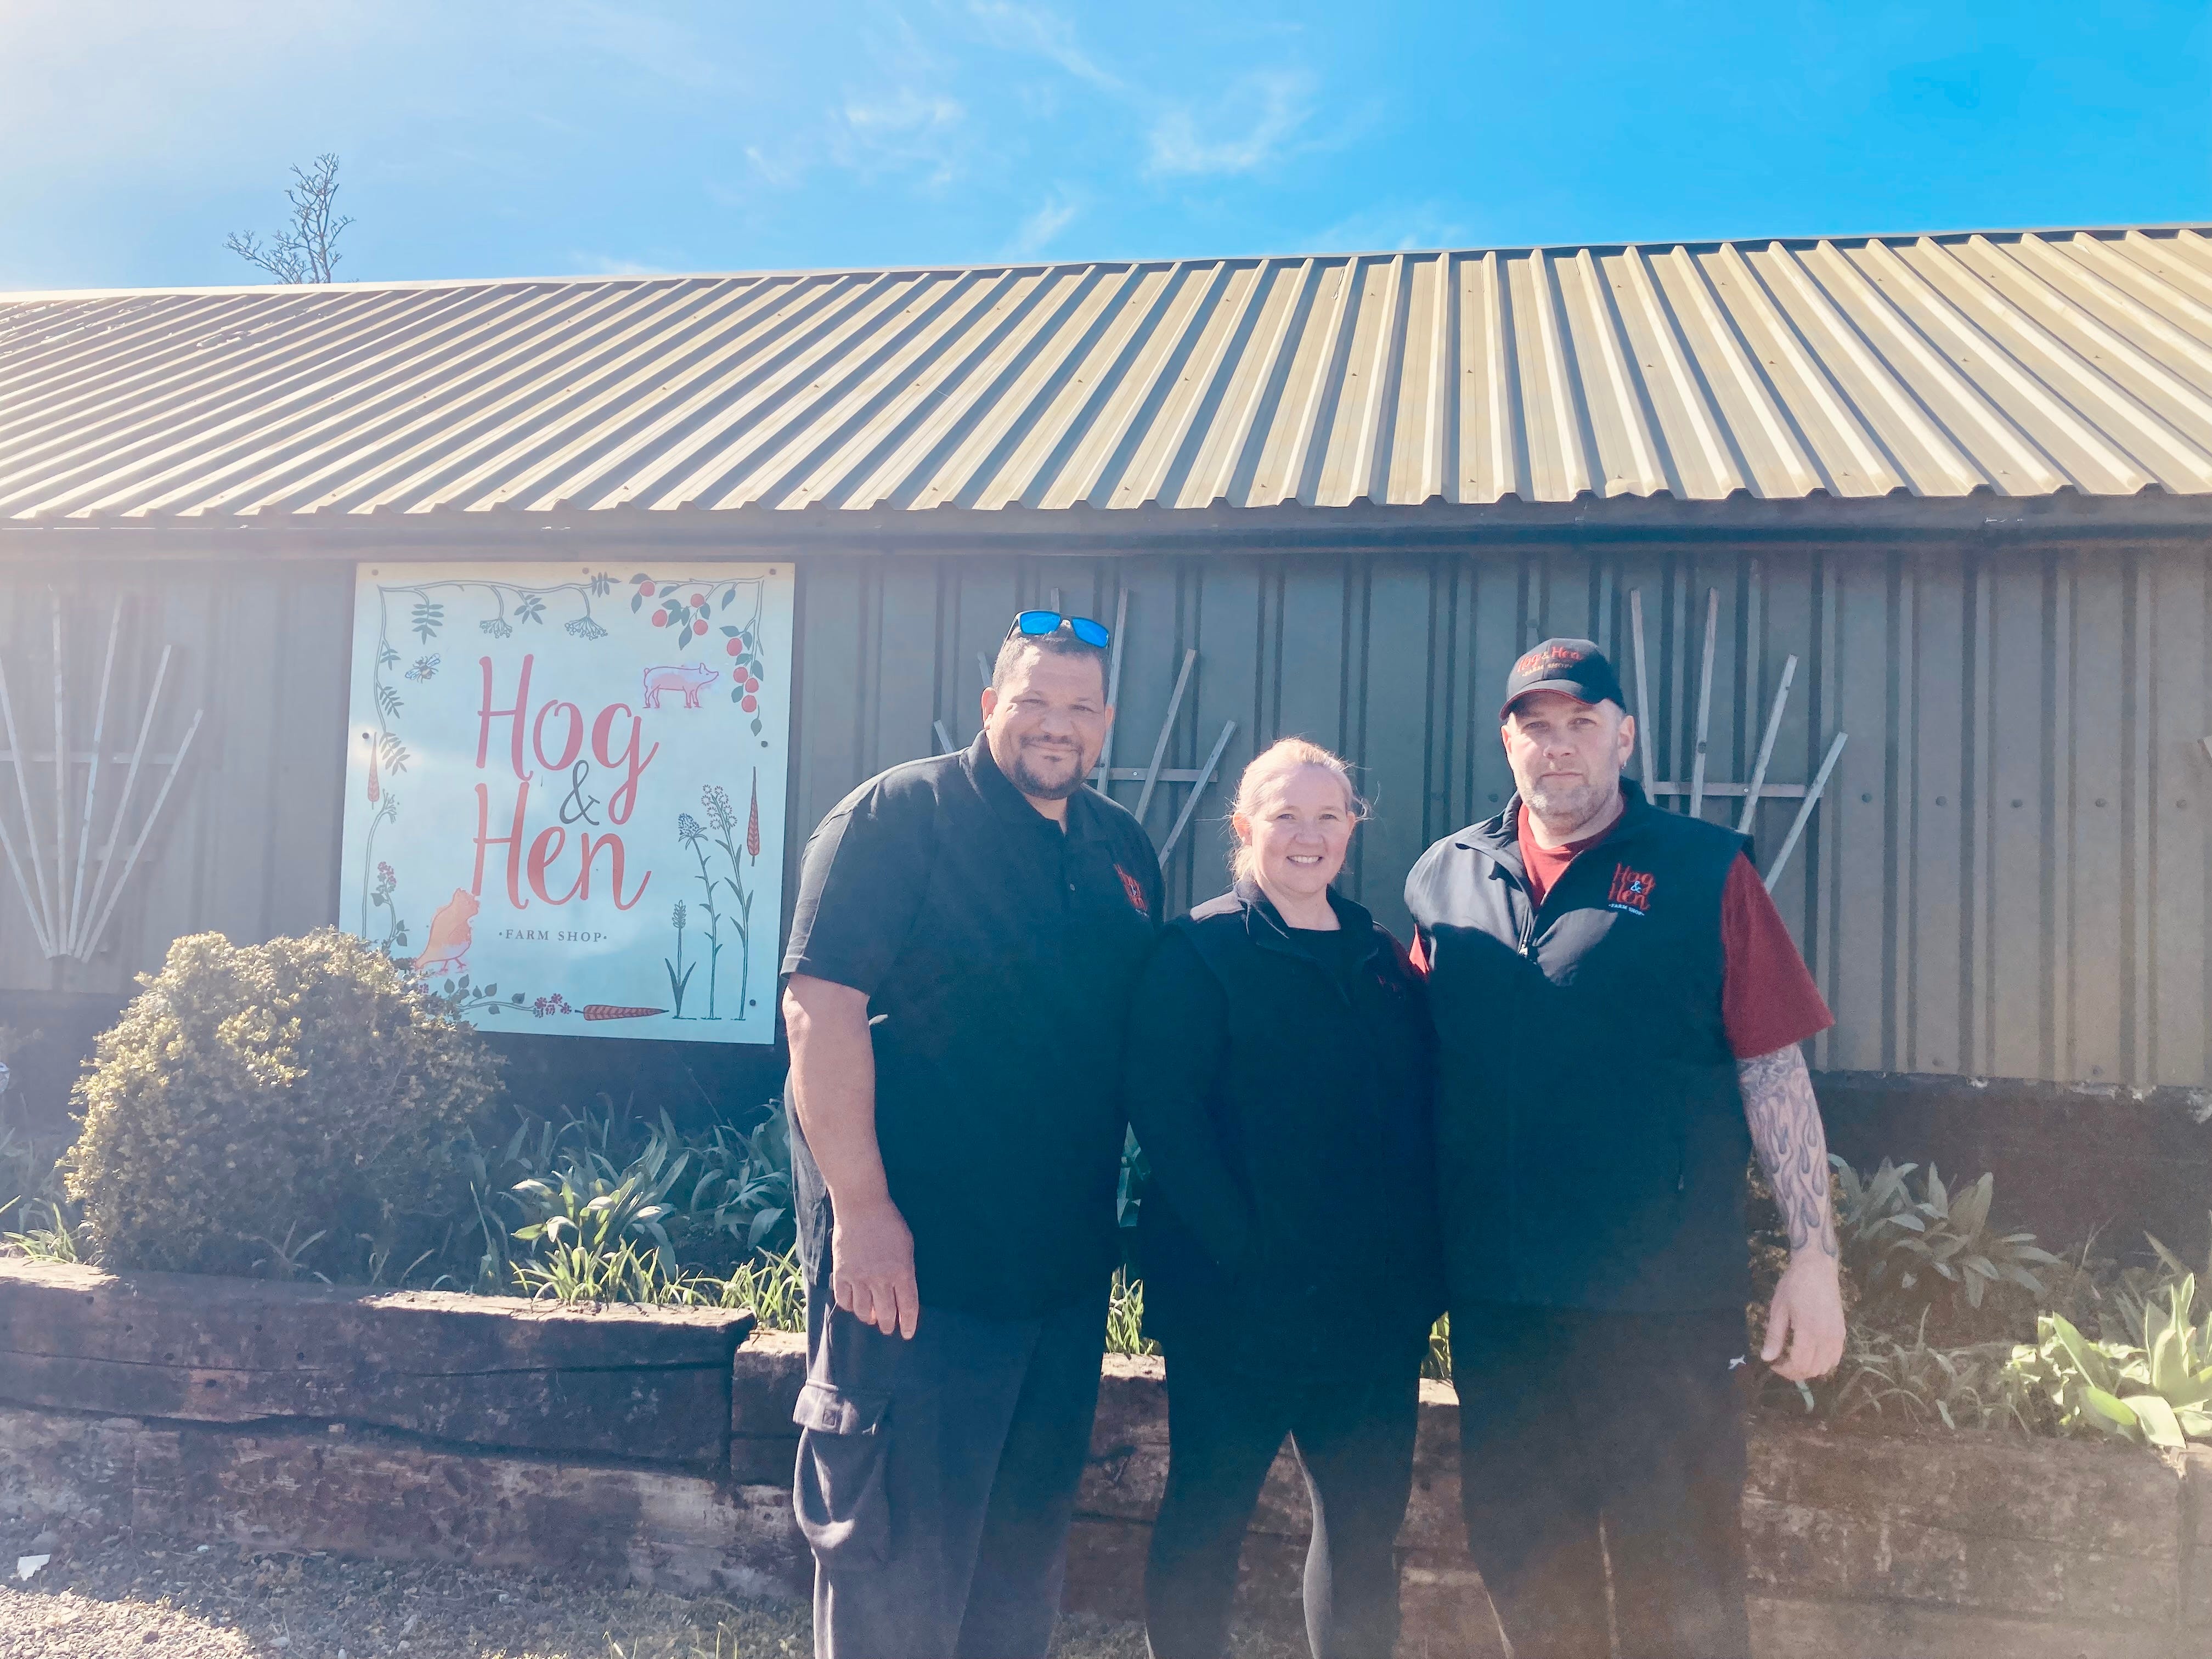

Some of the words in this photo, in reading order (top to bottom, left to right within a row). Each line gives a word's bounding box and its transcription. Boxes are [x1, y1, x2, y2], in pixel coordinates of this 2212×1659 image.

[475, 653, 659, 825] Hog
[558, 759, 600, 826] &
[471, 781, 652, 911] Hen
[1630, 880, 1643, 893] &
[505, 929, 549, 940] FARM
[558, 930, 602, 943] SHOP
